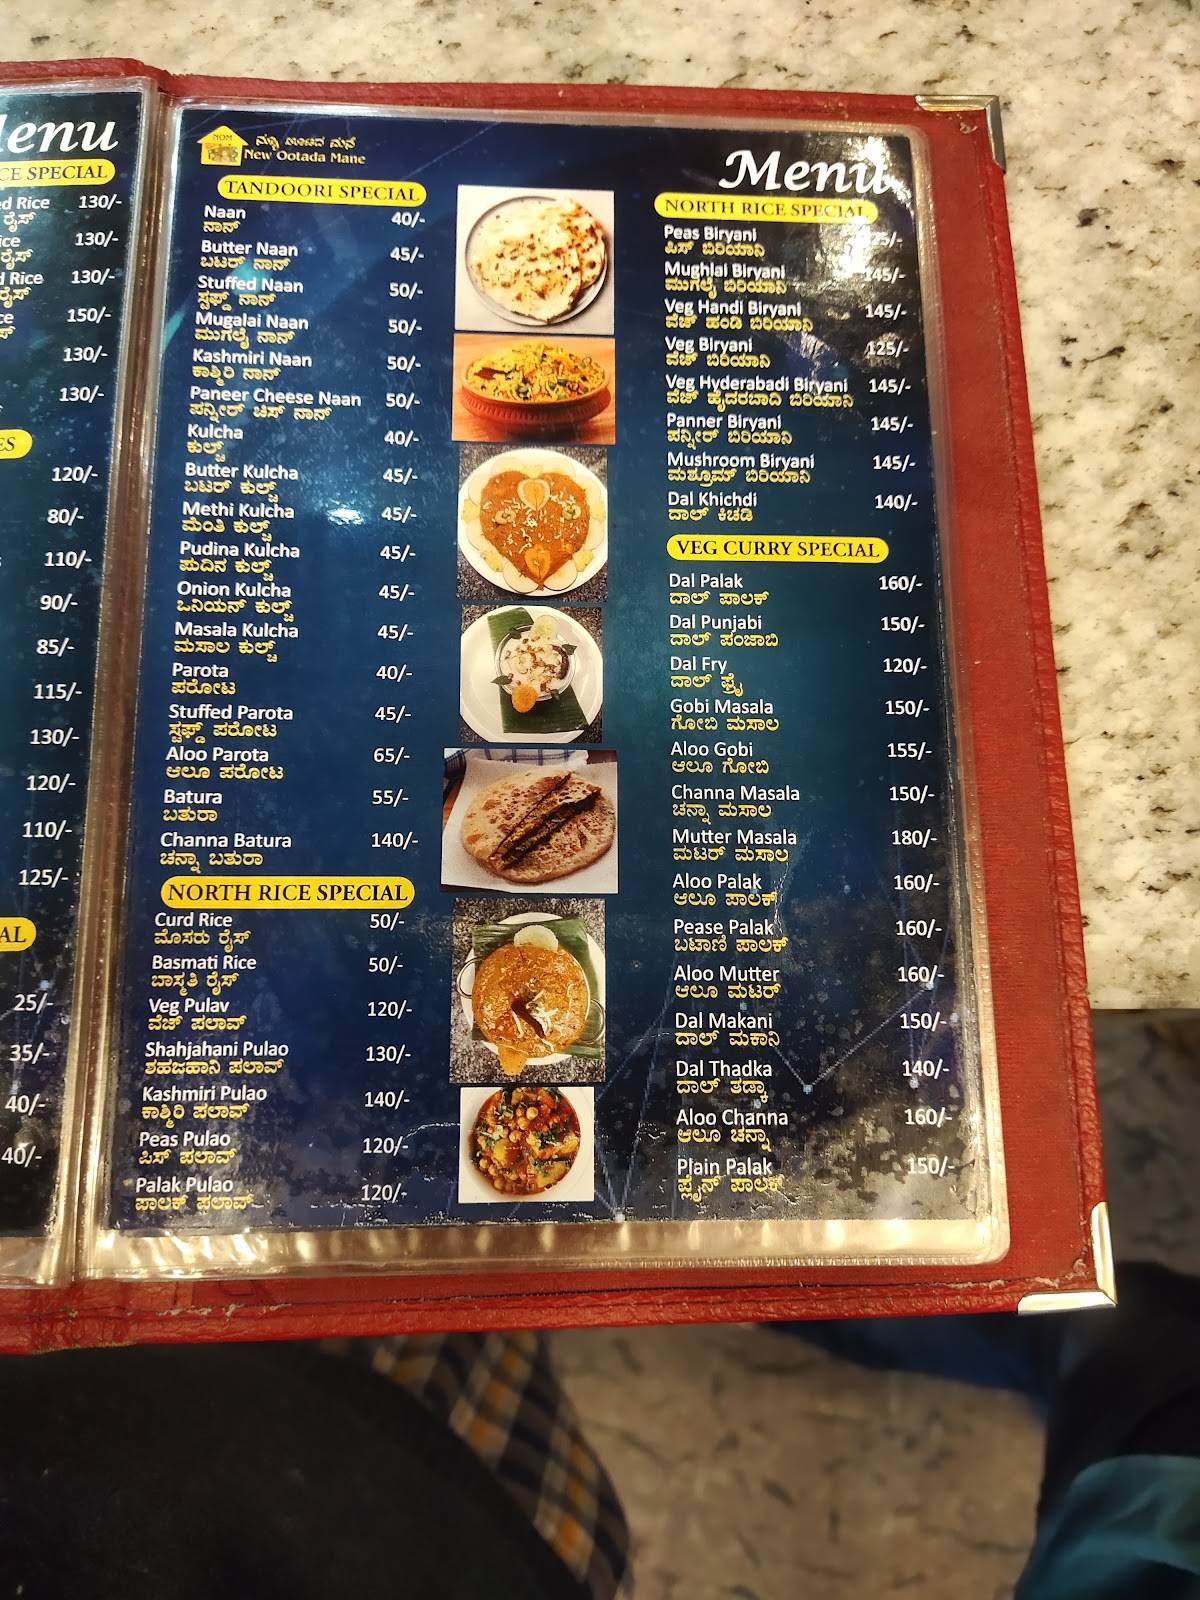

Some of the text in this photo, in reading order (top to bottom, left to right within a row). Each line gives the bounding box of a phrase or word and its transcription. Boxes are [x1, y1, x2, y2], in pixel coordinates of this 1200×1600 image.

[244, 149, 367, 165] New Ootada Mane
[27, 165, 108, 181] SPECIAL
[718, 150, 891, 195] Menu
[224, 180, 421, 203] TANDOORI SPECIAL
[17, 196, 51, 210] Rice
[79, 194, 121, 209] 130/-
[664, 198, 735, 215] NORTH
[742, 200, 786, 216] RICE
[205, 205, 245, 218] Naan
[392, 212, 425, 227] 40/-
[665, 225, 756, 243] Peas Biryani
[202, 240, 298, 256] Butter Naan
[391, 247, 424, 263] 45/-
[10, 271, 44, 285] Rice
[665, 262, 785, 280] Mughlai Biryani
[198, 276, 304, 293] Stuffed Naan
[67, 307, 111, 323] 150/-
[665, 299, 801, 318] Veg Handi Biryani
[866, 304, 906, 320] 145/-
[196, 312, 309, 330] Mugalai Naan
[665, 336, 752, 354] Veg Biryani
[193, 349, 312, 368] Kashmiri Naan
[387, 356, 421, 372] 50/-
[666, 375, 847, 395] Veg Hyderabadi Biryani
[190, 386, 361, 406] Paneer Cheese Naan
[667, 413, 781, 431] Panner Biryani
[871, 416, 913, 433] 145/-
[188, 424, 243, 439] Kulcha
[667, 452, 814, 471] Mushroom Biryani
[52, 465, 98, 483] 120/-
[186, 462, 298, 480] Butter Kulcha
[383, 468, 418, 485] 45/-
[669, 492, 756, 506] Dal Khichdi
[875, 494, 917, 511] 140/-
[47, 508, 84, 525] 80/-
[183, 502, 294, 518] Methi Kulcha
[180, 541, 299, 558] Pudina Kulcha
[676, 540, 880, 558] VEG CURRY SPECIAL
[177, 581, 291, 597] Onion Kulcha
[670, 573, 743, 588] Dal Palak
[879, 575, 922, 592] 160/-
[41, 594, 77, 612] 90/-
[175, 622, 298, 637] Masala Kulcha
[670, 614, 761, 633] Dal Punjabi
[173, 663, 228, 677] Parota
[377, 665, 412, 682] 40/-
[671, 656, 727, 674] Dal Fry
[884, 658, 926, 675] 120/-
[34, 682, 82, 701] 115/-
[168, 704, 293, 720] Stuffed Parota
[671, 698, 773, 714] Gobi Masala
[166, 746, 268, 761] Aloo Parota
[374, 747, 409, 764] 65/-
[671, 741, 752, 756] Aloo Gobi
[888, 742, 931, 760] 155/-
[27, 774, 75, 793] 120/-
[672, 784, 799, 800] Channa Masala
[164, 789, 222, 804] Batura
[161, 832, 291, 847] Channa Batura
[372, 832, 418, 849] 140/-
[673, 829, 797, 845] Mutter Masala
[892, 829, 937, 847] 180/-
[19, 868, 68, 887] 125/-
[673, 873, 762, 890] Aloo Palak
[168, 884, 408, 901] NORTH RICE SPECIAL
[155, 912, 232, 926] Curd Rice
[674, 919, 775, 936] Pease Palak
[896, 919, 941, 938] 160/-
[153, 955, 256, 969] Basmati Rice
[369, 956, 402, 974] 50/-
[674, 965, 779, 981] Aloo Mutter
[14, 993, 53, 1013] 25/-
[149, 998, 230, 1017] Veg Pulav
[676, 1012, 772, 1028] Dal Makani
[146, 1041, 288, 1062] Shahjahani Pulao
[367, 1045, 410, 1064] 130/-
[677, 1060, 773, 1077] Dal Thadka
[143, 1085, 267, 1101] Kashmiri Pulao
[676, 1108, 788, 1125] Aloo Channa
[140, 1130, 230, 1146] Peas Pulao
[678, 1157, 772, 1175] Plain Palak
[909, 1156, 954, 1177] 150/-
[136, 1176, 233, 1192] Palak Pulao
